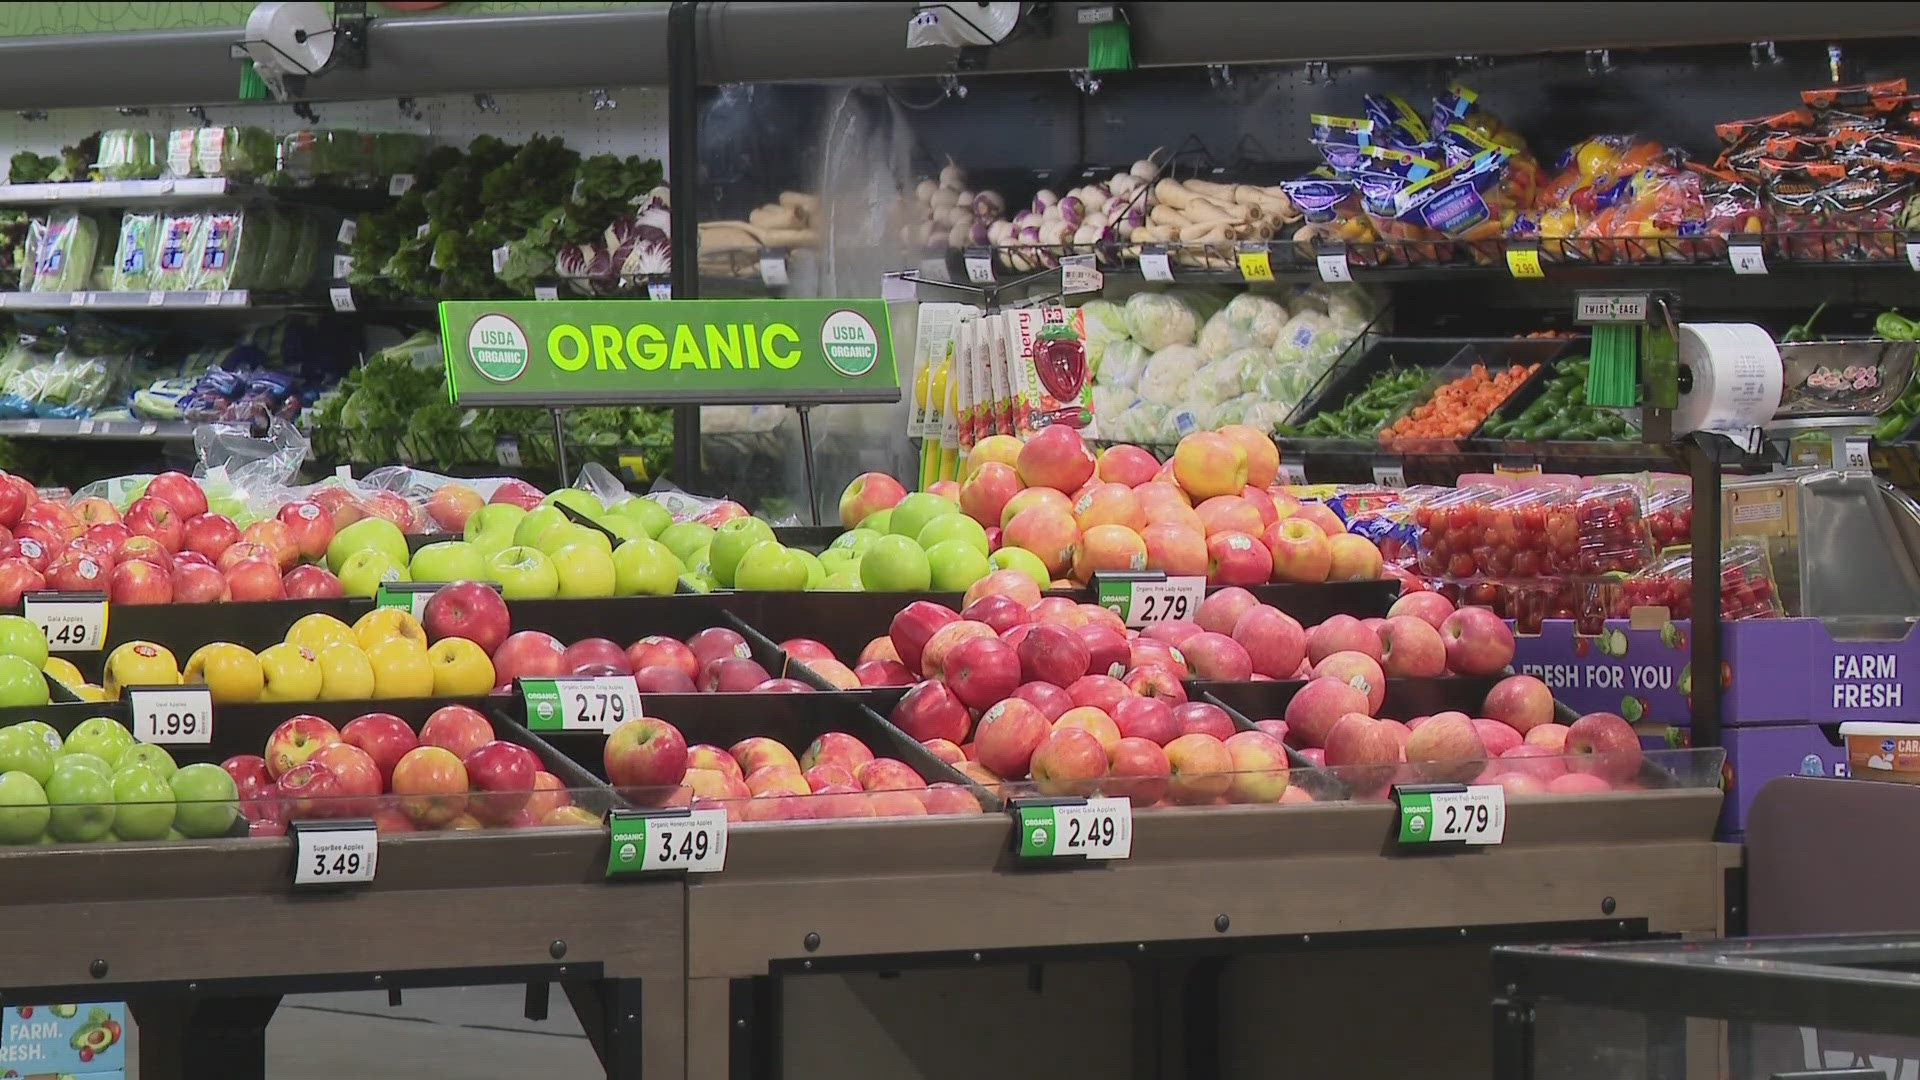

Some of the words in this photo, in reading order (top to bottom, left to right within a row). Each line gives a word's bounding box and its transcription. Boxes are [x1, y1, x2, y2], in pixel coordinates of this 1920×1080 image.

[1515, 263, 1536, 274] 2.99
[1585, 304, 1608, 314] TWIST
[1619, 304, 1638, 314] EASE
[481, 330, 515, 345] USDA
[833, 326, 865, 340] USDA
[547, 322, 801, 372] ORGANIC
[831, 345, 872, 358] ORGANIC
[478, 350, 521, 364] ORGANIC
[1019, 313, 1040, 407] strawberry
[1102, 595, 1129, 603] ORGANIC
[1140, 595, 1187, 621] 2.79
[63, 615, 84, 623] Apples
[41, 624, 86, 645] 1.49
[1834, 654, 1897, 679] FARM
[1586, 665, 1624, 688] FOR
[1630, 665, 1673, 689] YOU
[527, 692, 558, 700] ORGANIC
[1833, 683, 1902, 708] FRESH
[576, 693, 625, 722] 2.79
[149, 713, 196, 735] 1.99
[1897, 739, 1920, 753] CAR
[1403, 806, 1431, 814] ORGANIC
[670, 820, 695, 828] Honeycrisp
[1025, 818, 1053, 827] ORGANIC
[1444, 804, 1488, 834] 2.79
[613, 833, 644, 842] ORGANIC
[1068, 816, 1115, 847] 2.49
[313, 844, 342, 852] SugarBee
[343, 843, 364, 851] Apples
[659, 830, 708, 862] 3.49
[313, 853, 360, 875] 3.49
[10, 1022, 63, 1041] FARM.
[0, 1043, 46, 1062] RESH.
